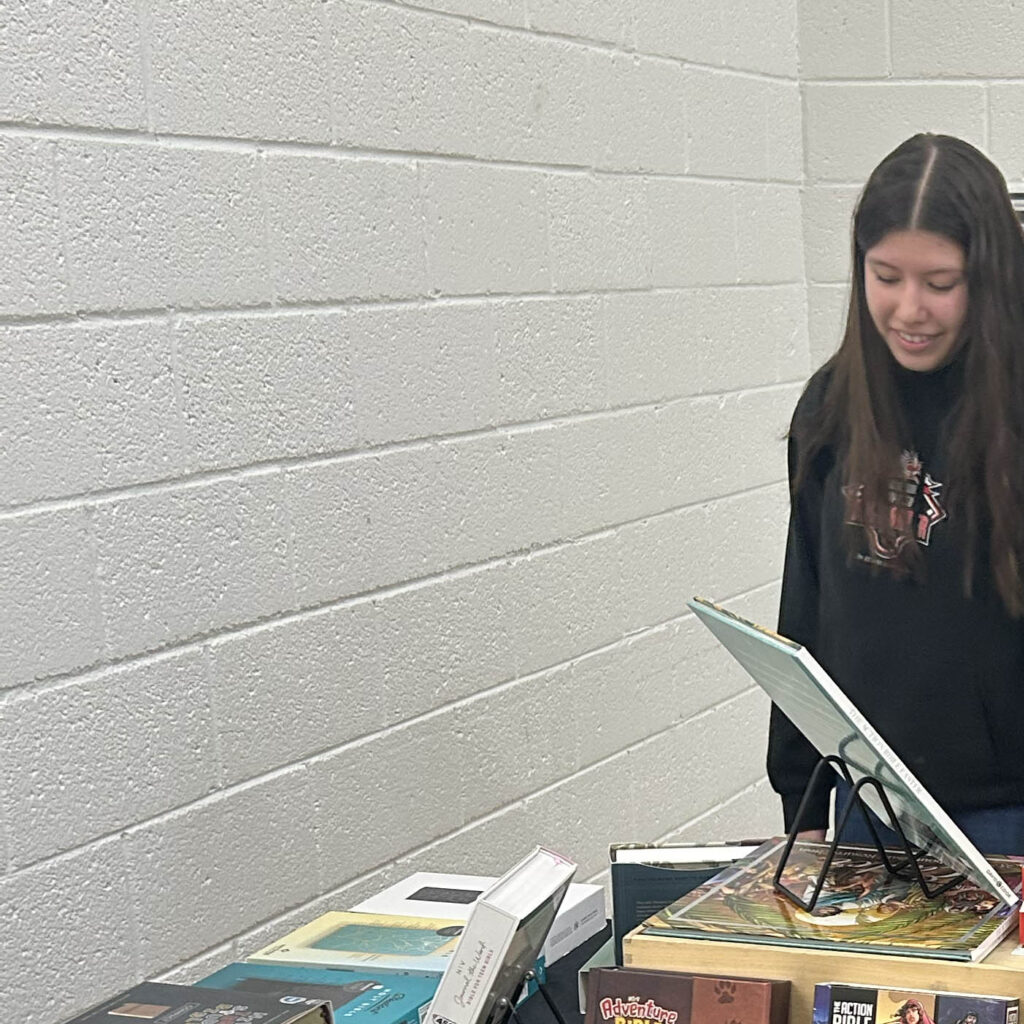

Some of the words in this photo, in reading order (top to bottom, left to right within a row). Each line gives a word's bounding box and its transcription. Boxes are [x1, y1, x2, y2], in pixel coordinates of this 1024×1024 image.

[456, 959, 466, 974] NIV
[833, 1000, 841, 1016] THE
[841, 1001, 873, 1018] ACTION
